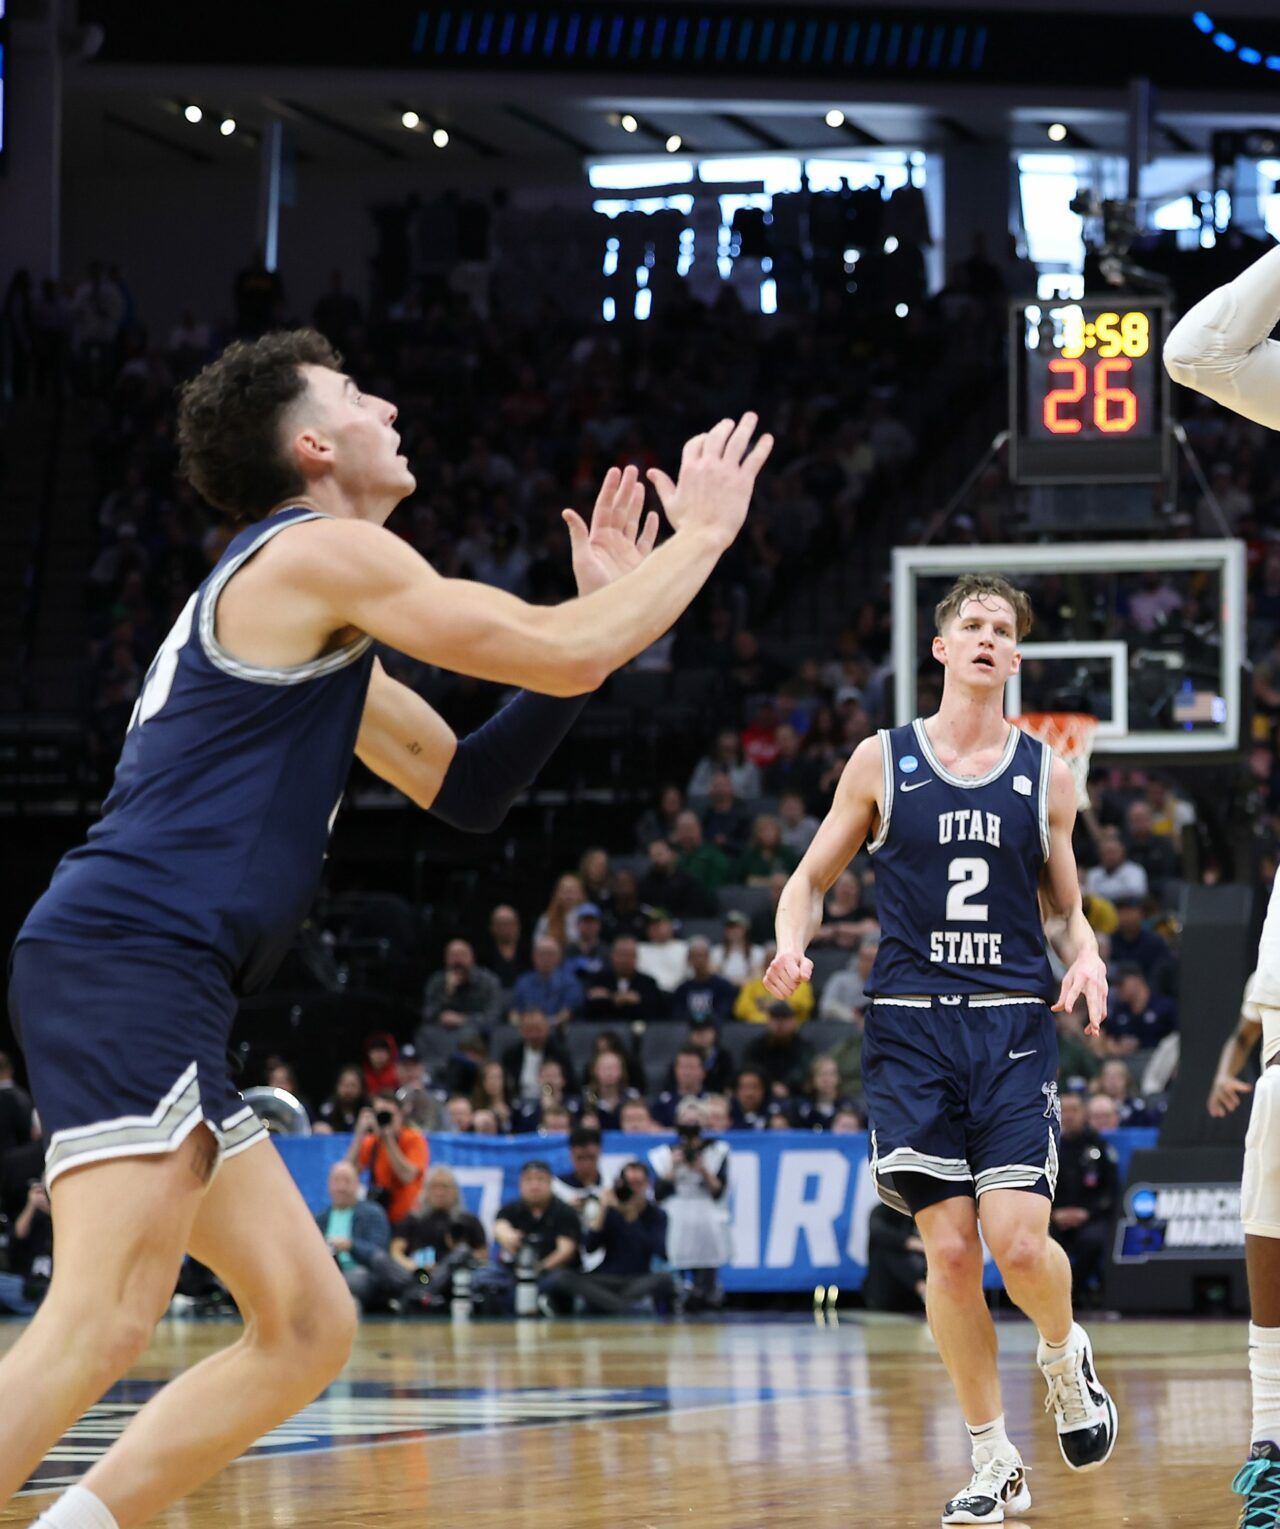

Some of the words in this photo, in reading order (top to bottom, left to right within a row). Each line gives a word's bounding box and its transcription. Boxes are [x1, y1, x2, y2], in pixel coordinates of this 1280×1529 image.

[1043, 357, 1137, 434] 26
[938, 809, 1001, 848] UTAH
[945, 857, 989, 921] 2
[929, 931, 1002, 965] STATE
